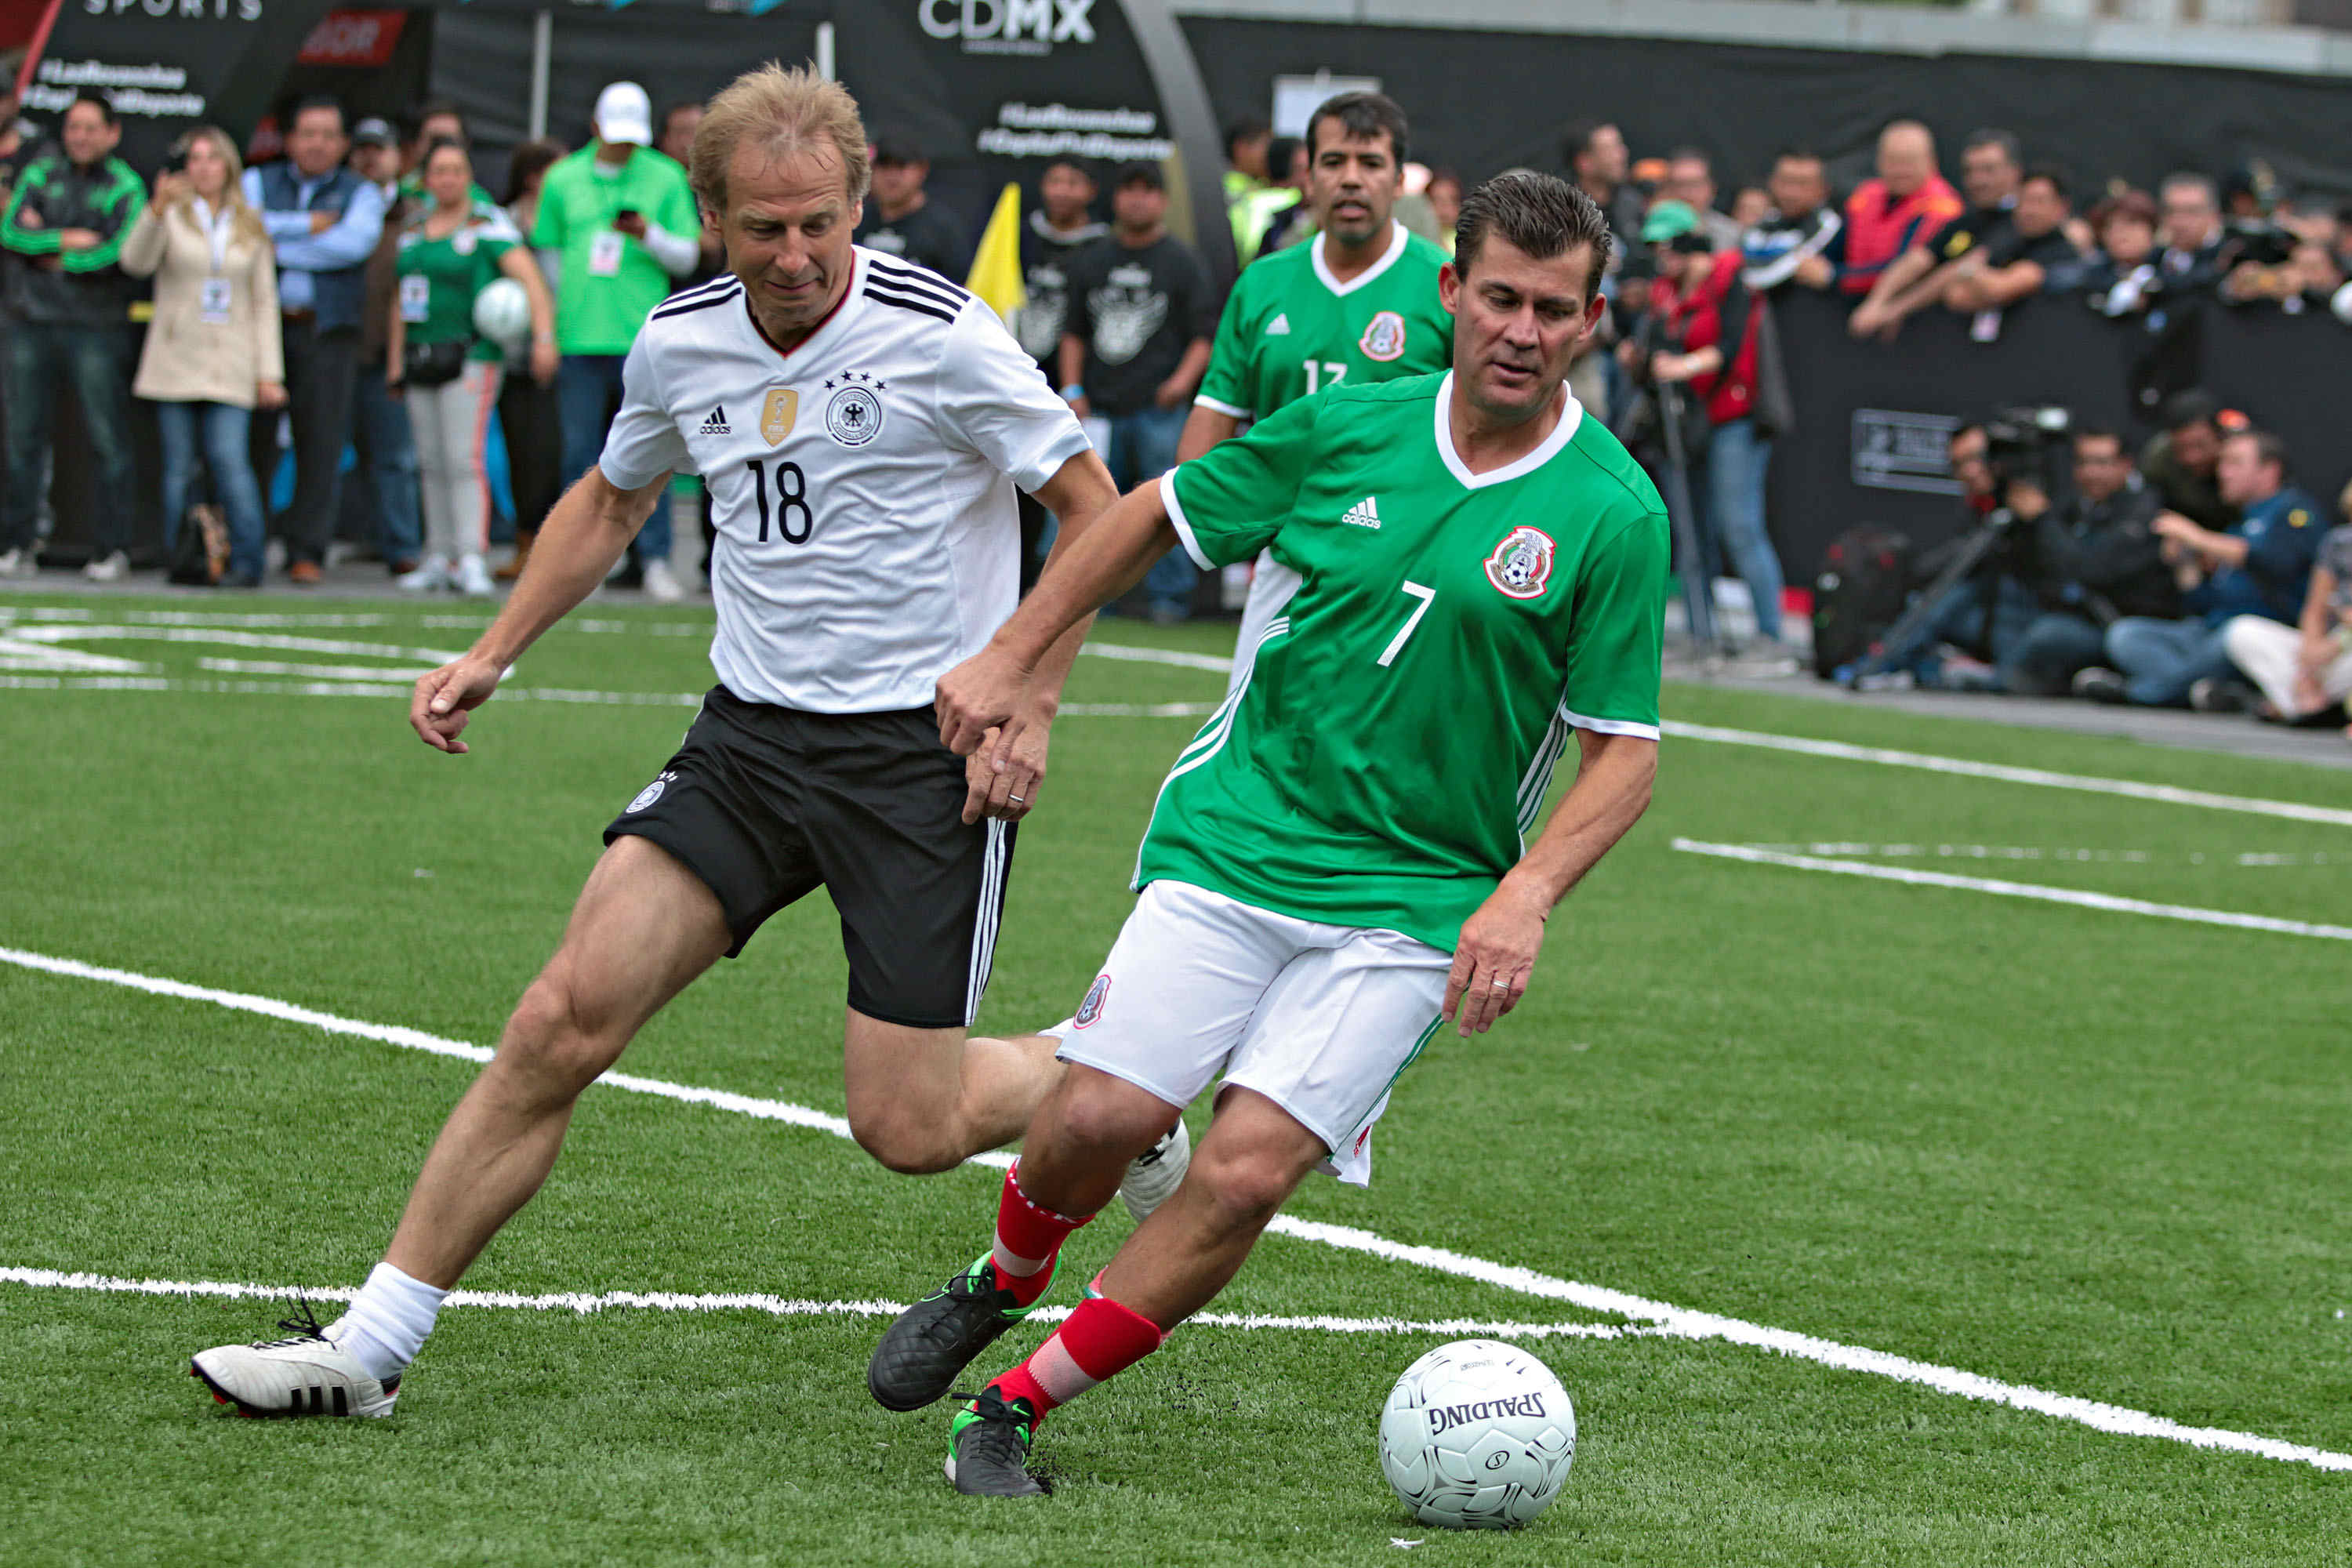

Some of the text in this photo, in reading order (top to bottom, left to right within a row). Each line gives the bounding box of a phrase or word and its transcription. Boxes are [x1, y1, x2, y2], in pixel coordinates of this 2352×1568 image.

[919, 0, 1095, 42] CDMX
[699, 426, 731, 434] adidas
[746, 460, 813, 545] 18
[1341, 514, 1381, 530] adidas
[1377, 579, 1436, 666] 7
[1428, 1392, 1546, 1436] SPALDING
